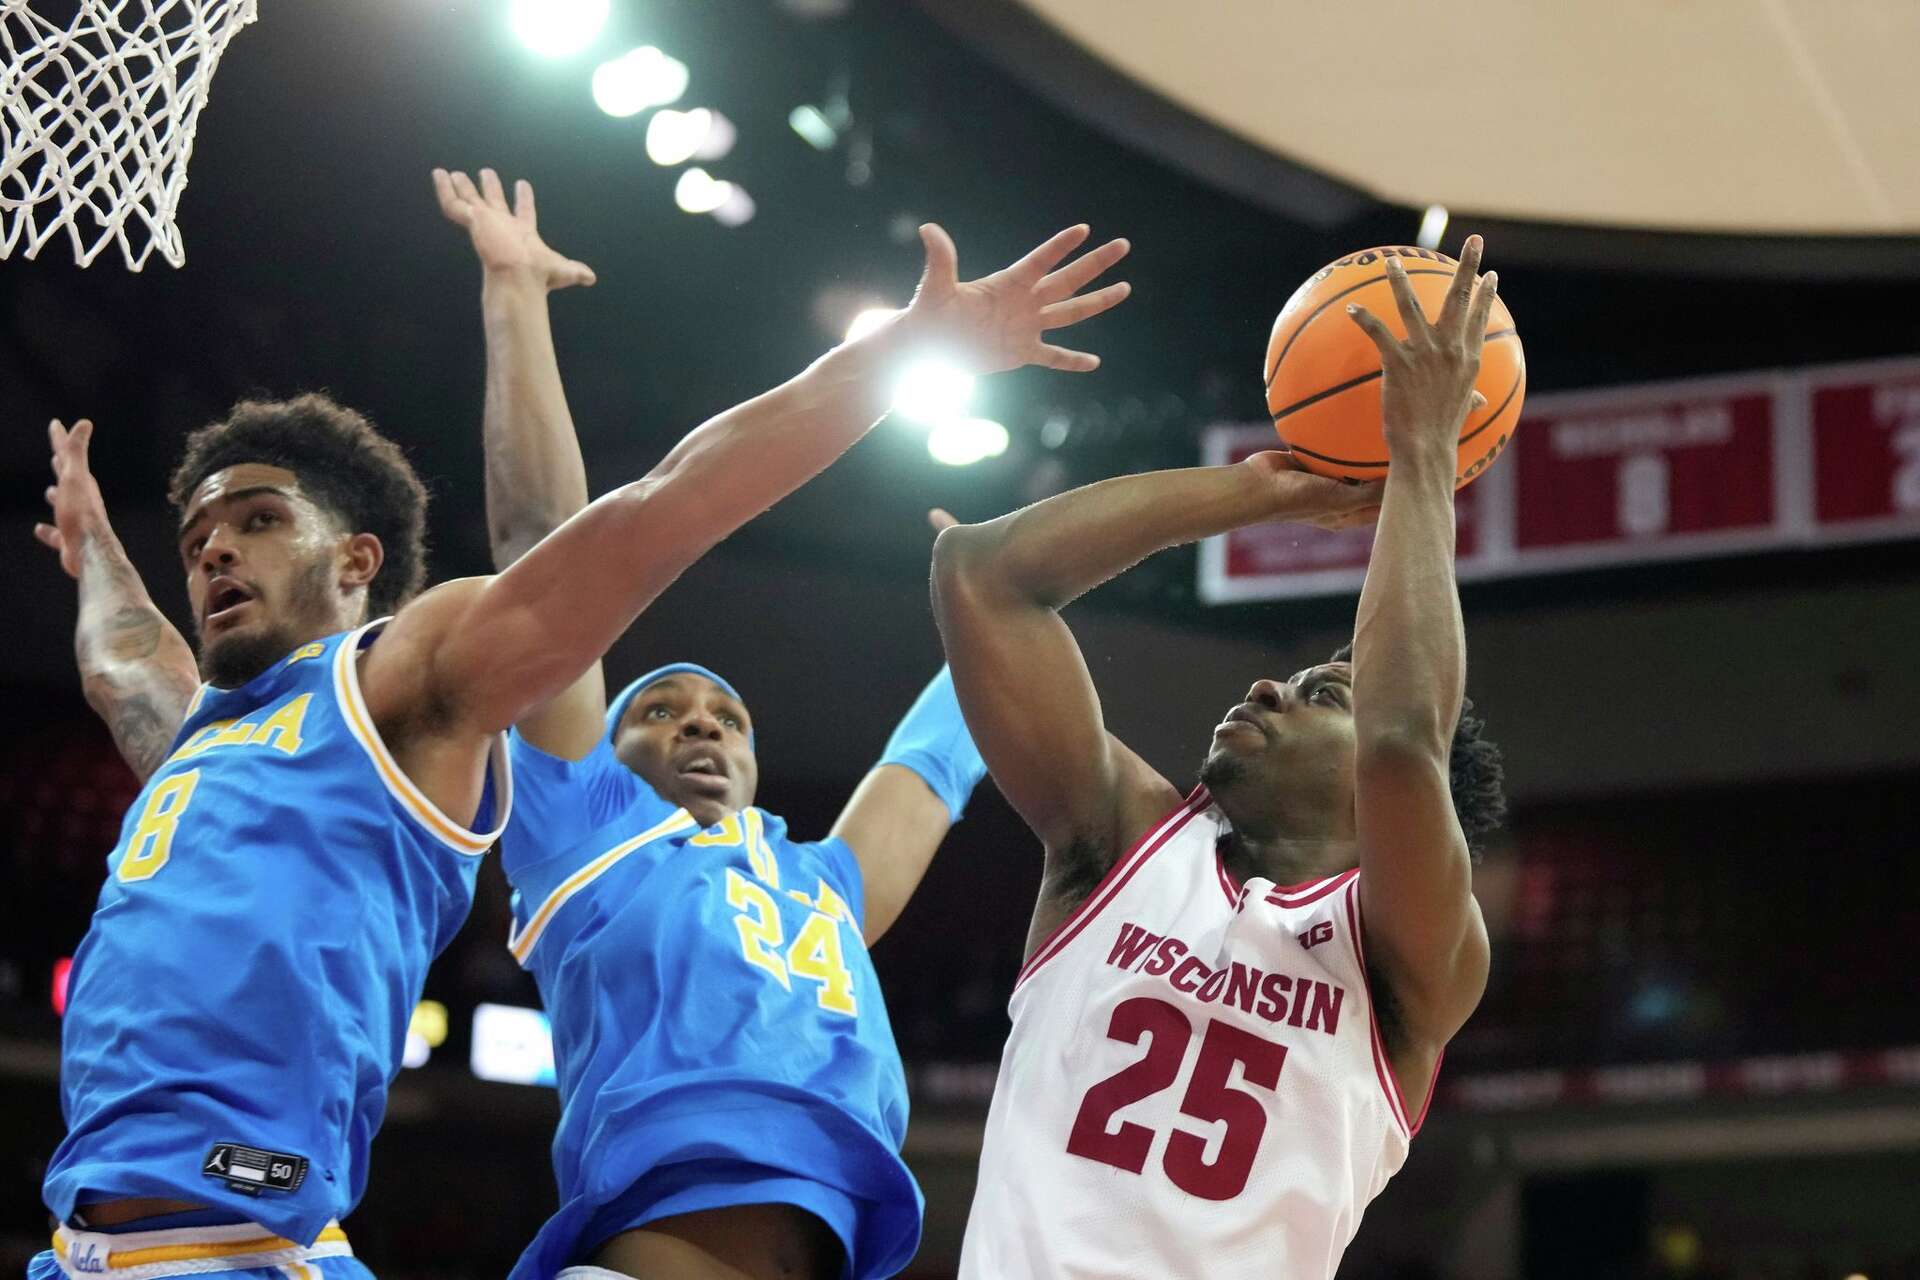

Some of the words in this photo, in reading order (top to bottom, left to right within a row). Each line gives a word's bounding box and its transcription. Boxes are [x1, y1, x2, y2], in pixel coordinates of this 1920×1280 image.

[116, 767, 201, 884] 8
[725, 866, 858, 1018] 24
[1066, 996, 1289, 1202] 25
[271, 1162, 292, 1180] 50
